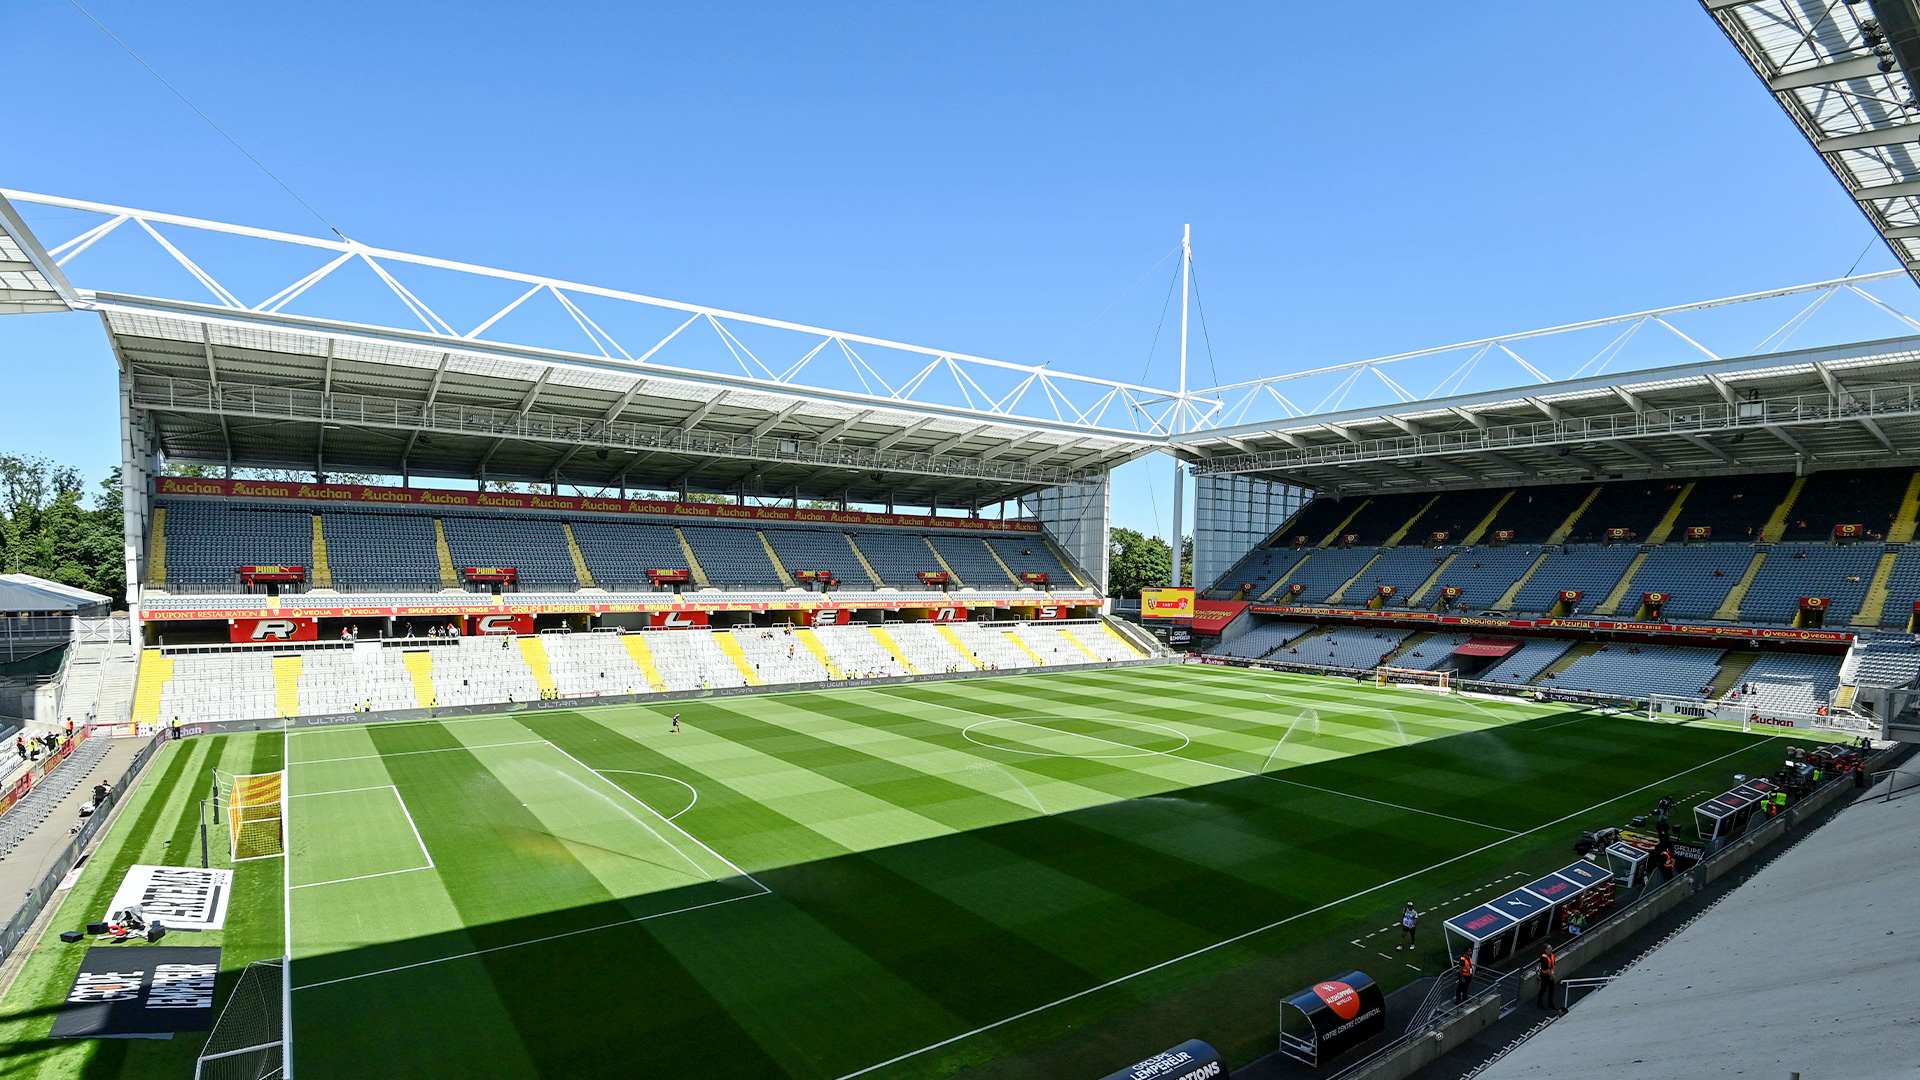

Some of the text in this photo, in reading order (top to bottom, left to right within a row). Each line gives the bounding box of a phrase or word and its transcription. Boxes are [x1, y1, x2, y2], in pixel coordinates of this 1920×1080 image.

[162, 479, 1038, 531] Auchan Auchan Auchan Auchan Auchan Auchan Auchan Auchan Auchan Auchan Auchan Auchan Auchan Auchan Auchan Auchan Auchan Auchan Auchan Auchan
[693, 602, 720, 610] Auchan
[726, 602, 752, 610] Auchan
[1039, 606, 1060, 618] S
[154, 610, 258, 619] DUPONT RESTAURATION
[664, 612, 695, 628] L
[817, 609, 840, 624] E
[478, 615, 515, 633] C
[1469, 618, 1511, 627] boulanger
[1560, 620, 1591, 628] Azurial
[251, 619, 298, 641] R
[721, 687, 754, 695] ULTRA
[537, 700, 578, 709] ULTRA
[1674, 705, 1705, 717] PUMA
[308, 715, 357, 725] ULTRA
[1749, 713, 1794, 727] Auchan
[1673, 844, 1702, 854] GROUPE
[1322, 1007, 1381, 1041] VOTRE CENTRE COMMERCIAL
[1130, 1051, 1192, 1080] LEMPEREUR
[1132, 1051, 1173, 1070] GROUPE
